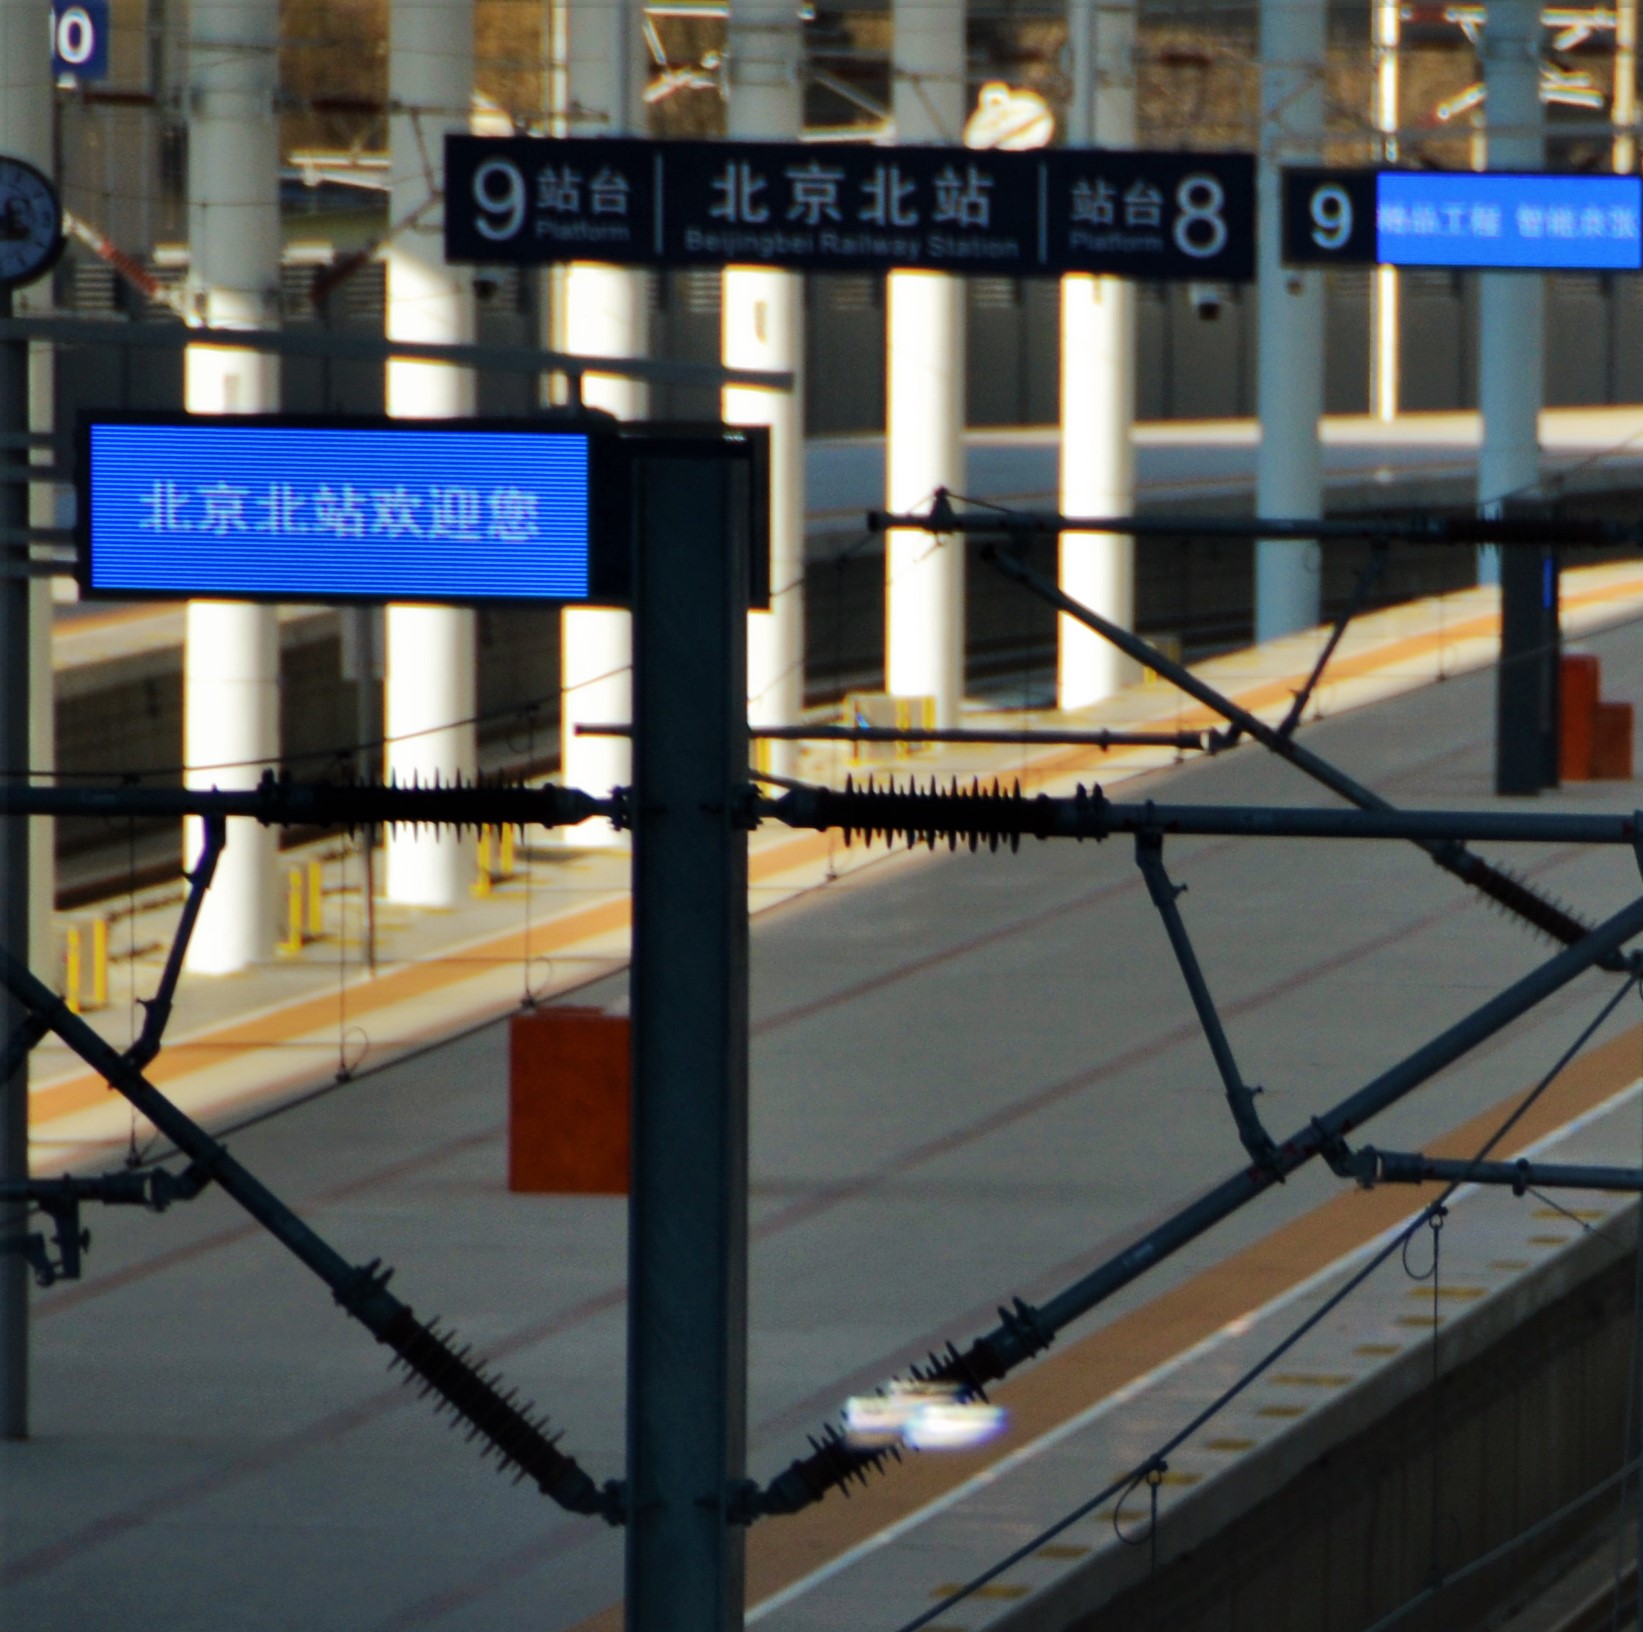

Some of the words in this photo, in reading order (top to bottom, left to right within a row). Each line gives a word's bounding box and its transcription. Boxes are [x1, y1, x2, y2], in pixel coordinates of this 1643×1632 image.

[50, 7, 95, 63] 0
[471, 153, 527, 242] 9
[535, 162, 632, 217] 站台
[707, 158, 996, 230] 北京北站
[1069, 176, 1165, 229] 站台
[1172, 171, 1229, 259] 8
[1309, 181, 1355, 250] 9
[535, 217, 632, 241] Platform
[684, 229, 813, 258] Beijingbei
[820, 232, 921, 261] Railway
[925, 235, 1020, 258] Station
[1069, 229, 1165, 253] Platform
[137, 479, 541, 543] 北京北站欢迎您
